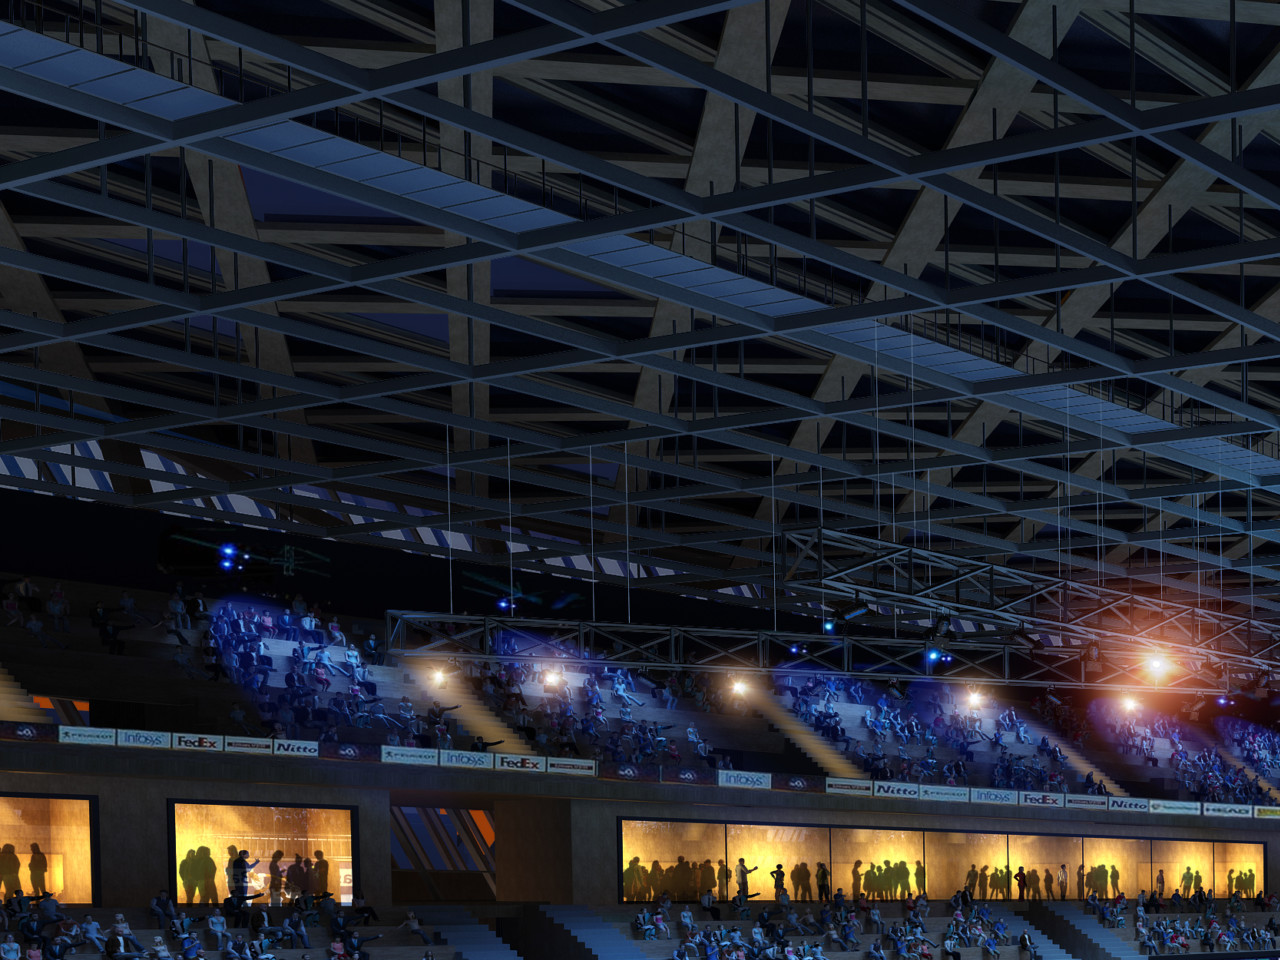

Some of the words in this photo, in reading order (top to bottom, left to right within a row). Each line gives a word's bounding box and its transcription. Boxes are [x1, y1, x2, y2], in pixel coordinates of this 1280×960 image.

[124, 731, 162, 745] Infosys
[178, 735, 217, 748] FedEx
[277, 743, 318, 753] Nitto
[447, 753, 485, 767] Infosys
[500, 757, 539, 769] FedEx
[725, 774, 763, 787] Infosys
[877, 785, 917, 794] Nitto
[977, 791, 1010, 803] Infosys
[1024, 794, 1058, 805] FedEx
[1111, 800, 1147, 810] Nitto
